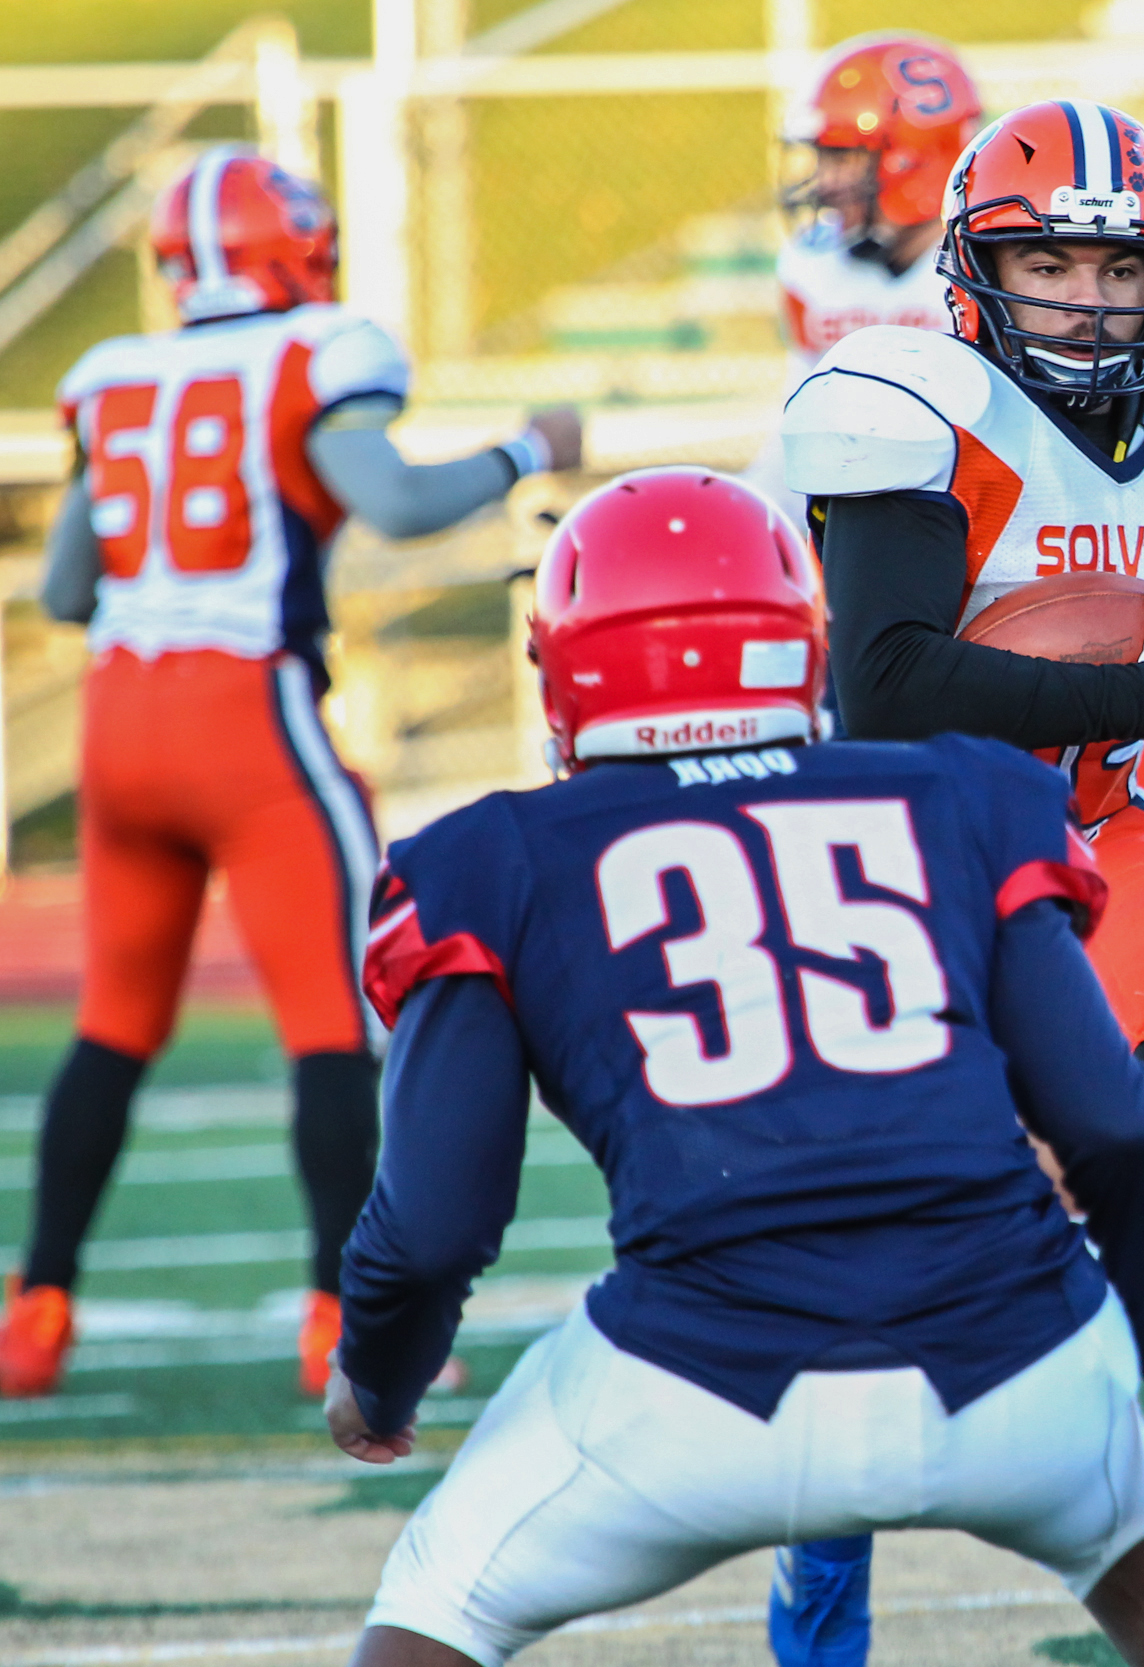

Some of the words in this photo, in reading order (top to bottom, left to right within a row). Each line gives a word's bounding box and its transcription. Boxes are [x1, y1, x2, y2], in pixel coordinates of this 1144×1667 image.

[1078, 197, 1114, 208] schutt
[90, 373, 253, 579] 58
[594, 797, 953, 1109] 35
